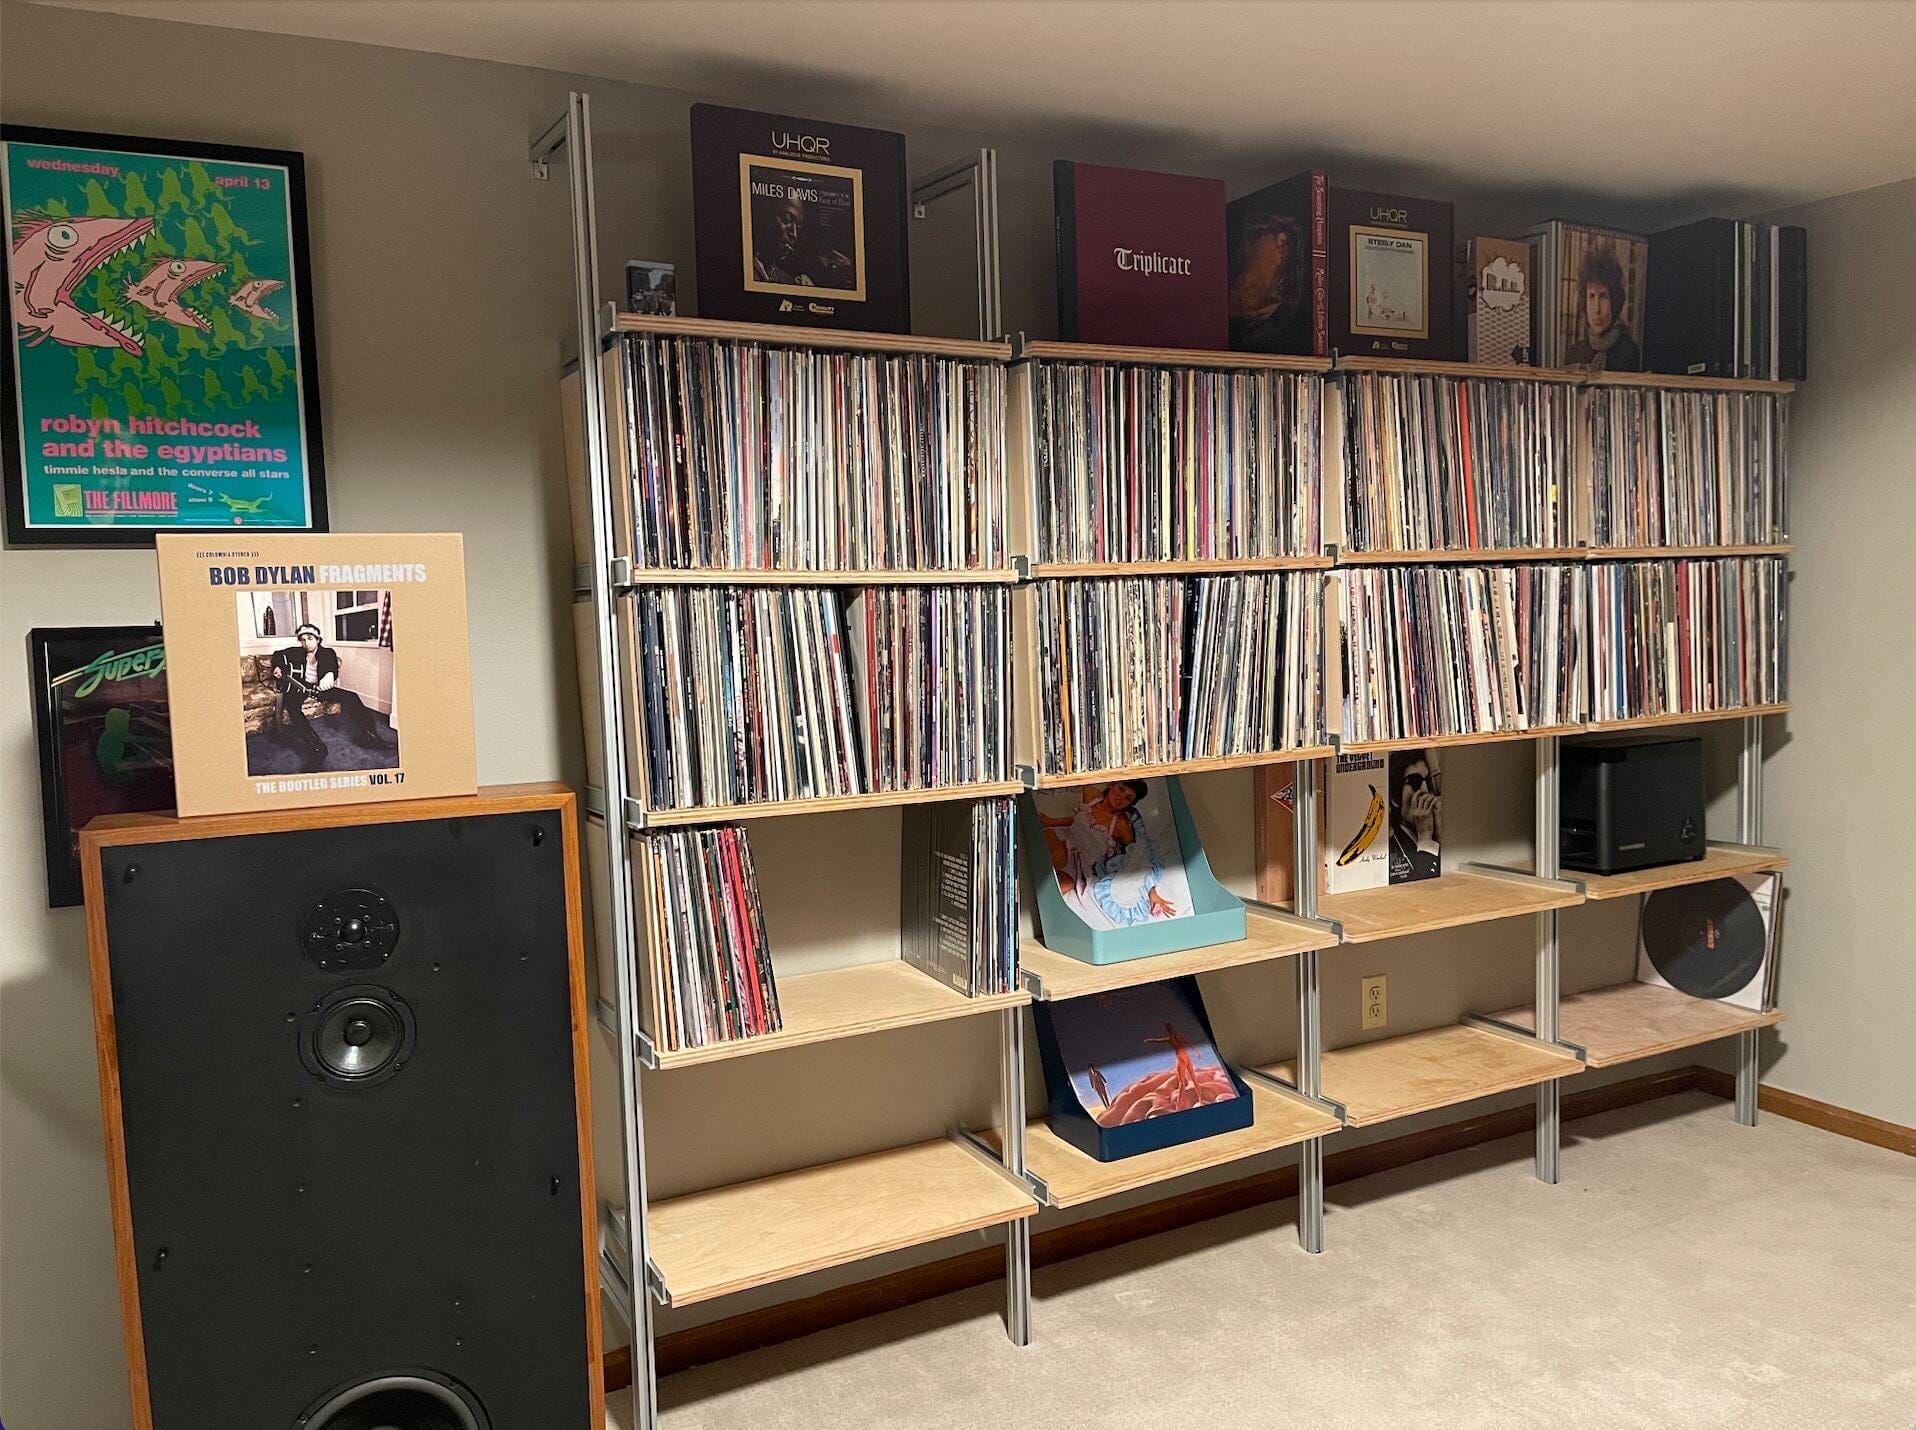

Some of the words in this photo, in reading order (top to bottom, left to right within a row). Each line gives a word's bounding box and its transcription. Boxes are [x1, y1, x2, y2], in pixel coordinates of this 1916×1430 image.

[771, 131, 830, 155] UHQR
[27, 158, 119, 177] wednesday
[215, 174, 248, 189] april
[254, 177, 271, 190] 13
[752, 181, 784, 198] MILES
[787, 187, 818, 202] DAVIS
[1113, 247, 1191, 276] Triplicate
[41, 414, 121, 437] robyn
[129, 415, 262, 438] hitchcock
[42, 439, 95, 457] and
[103, 440, 149, 458] the
[157, 442, 288, 464] egyptians
[44, 465, 89, 475] timmie
[93, 465, 128, 475] hesla
[130, 467, 154, 476] and
[158, 467, 178, 477] the
[182, 468, 238, 478] converse
[242, 469, 256, 478] all
[259, 469, 290, 479] stars
[83, 490, 108, 510] THE
[113, 490, 178, 511] FILLMORE
[209, 566, 250, 586] BOB
[255, 565, 315, 585] DYLAN
[319, 563, 427, 584] FRAGMENTS
[1336, 759, 1384, 773] UNDERGROUND
[255, 782, 278, 794] THE
[279, 779, 328, 792] BOOTLEG
[329, 776, 367, 789] SERIES
[369, 773, 392, 785] VOL.
[395, 773, 405, 784] 17
